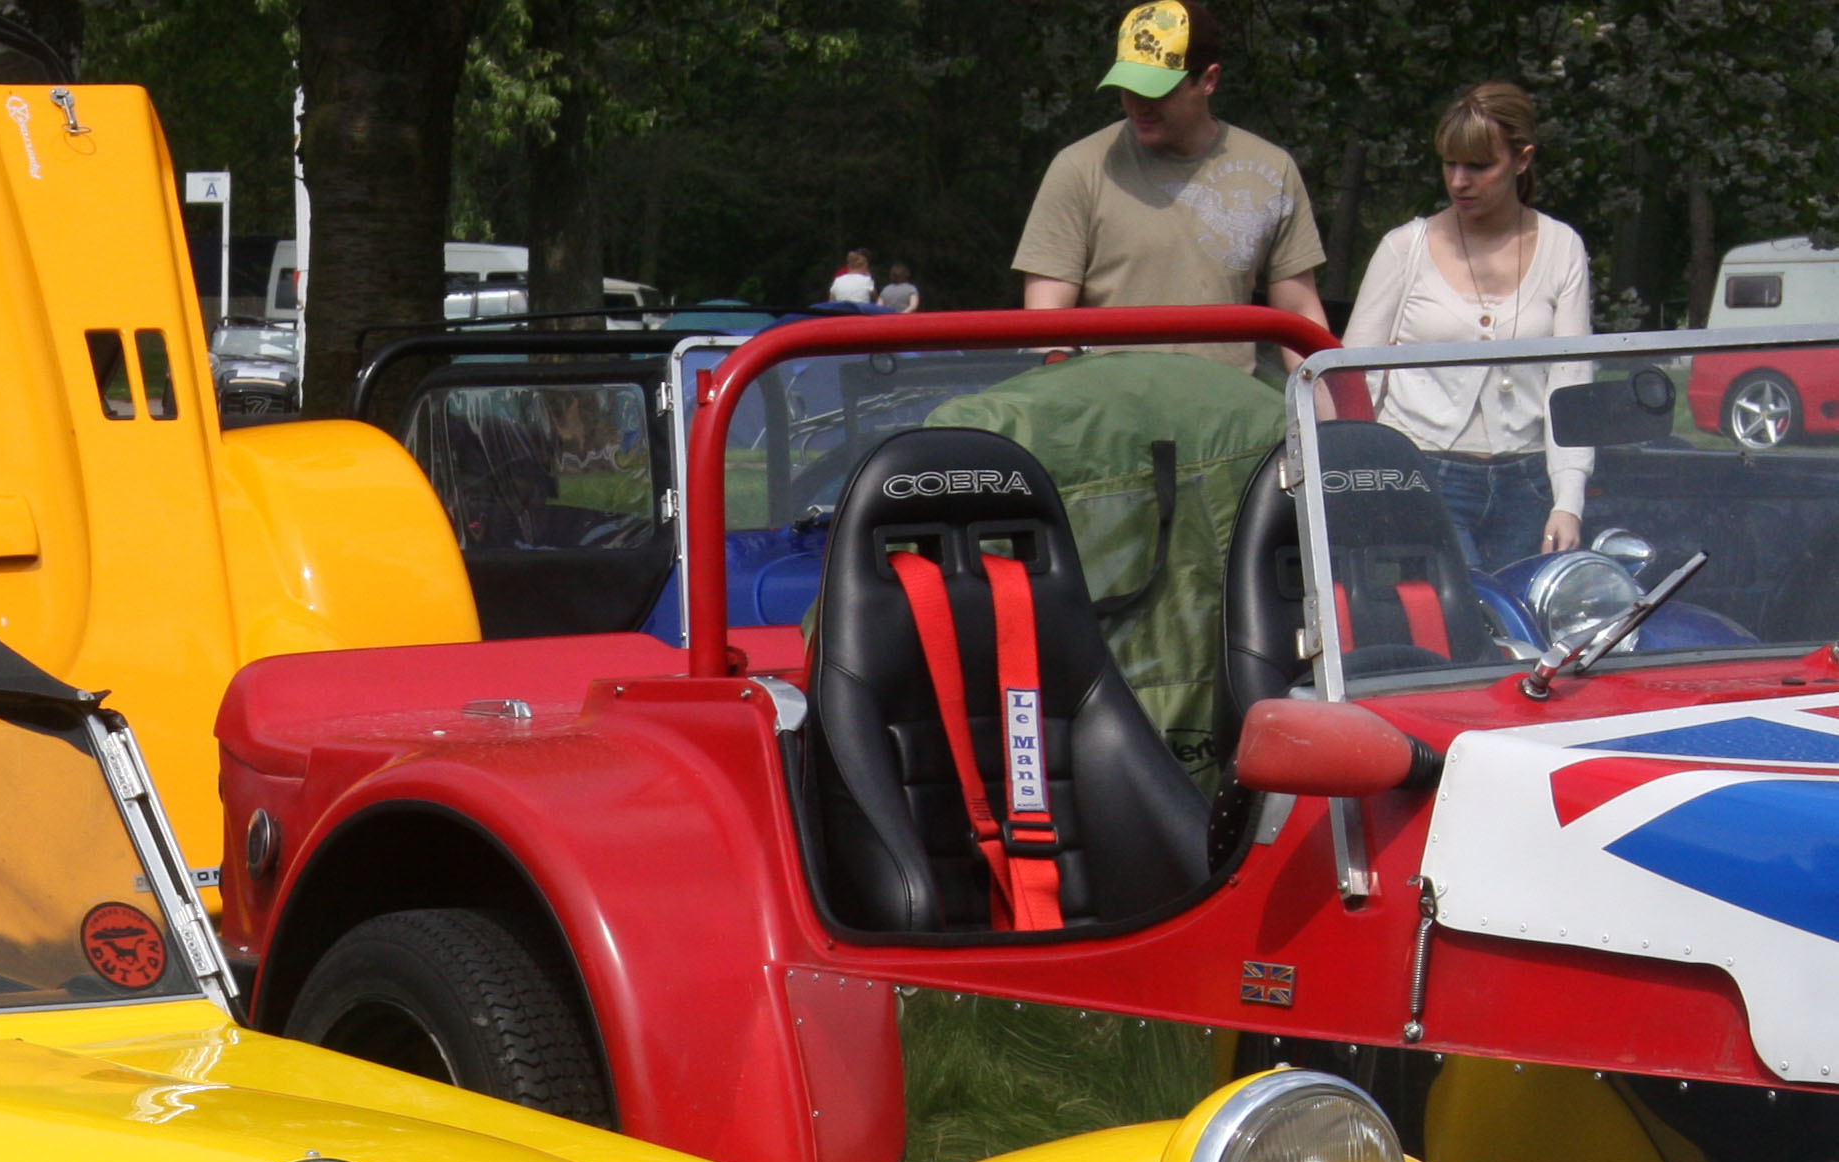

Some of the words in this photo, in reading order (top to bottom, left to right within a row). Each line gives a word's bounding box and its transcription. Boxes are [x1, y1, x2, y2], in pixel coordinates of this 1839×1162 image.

[205, 182, 218, 198] A
[883, 470, 1032, 499] COBRA
[1285, 469, 1431, 498] OBRA
[1012, 694, 1034, 724] Le
[1012, 735, 1037, 796] Mans
[90, 940, 161, 983] DUTTON
